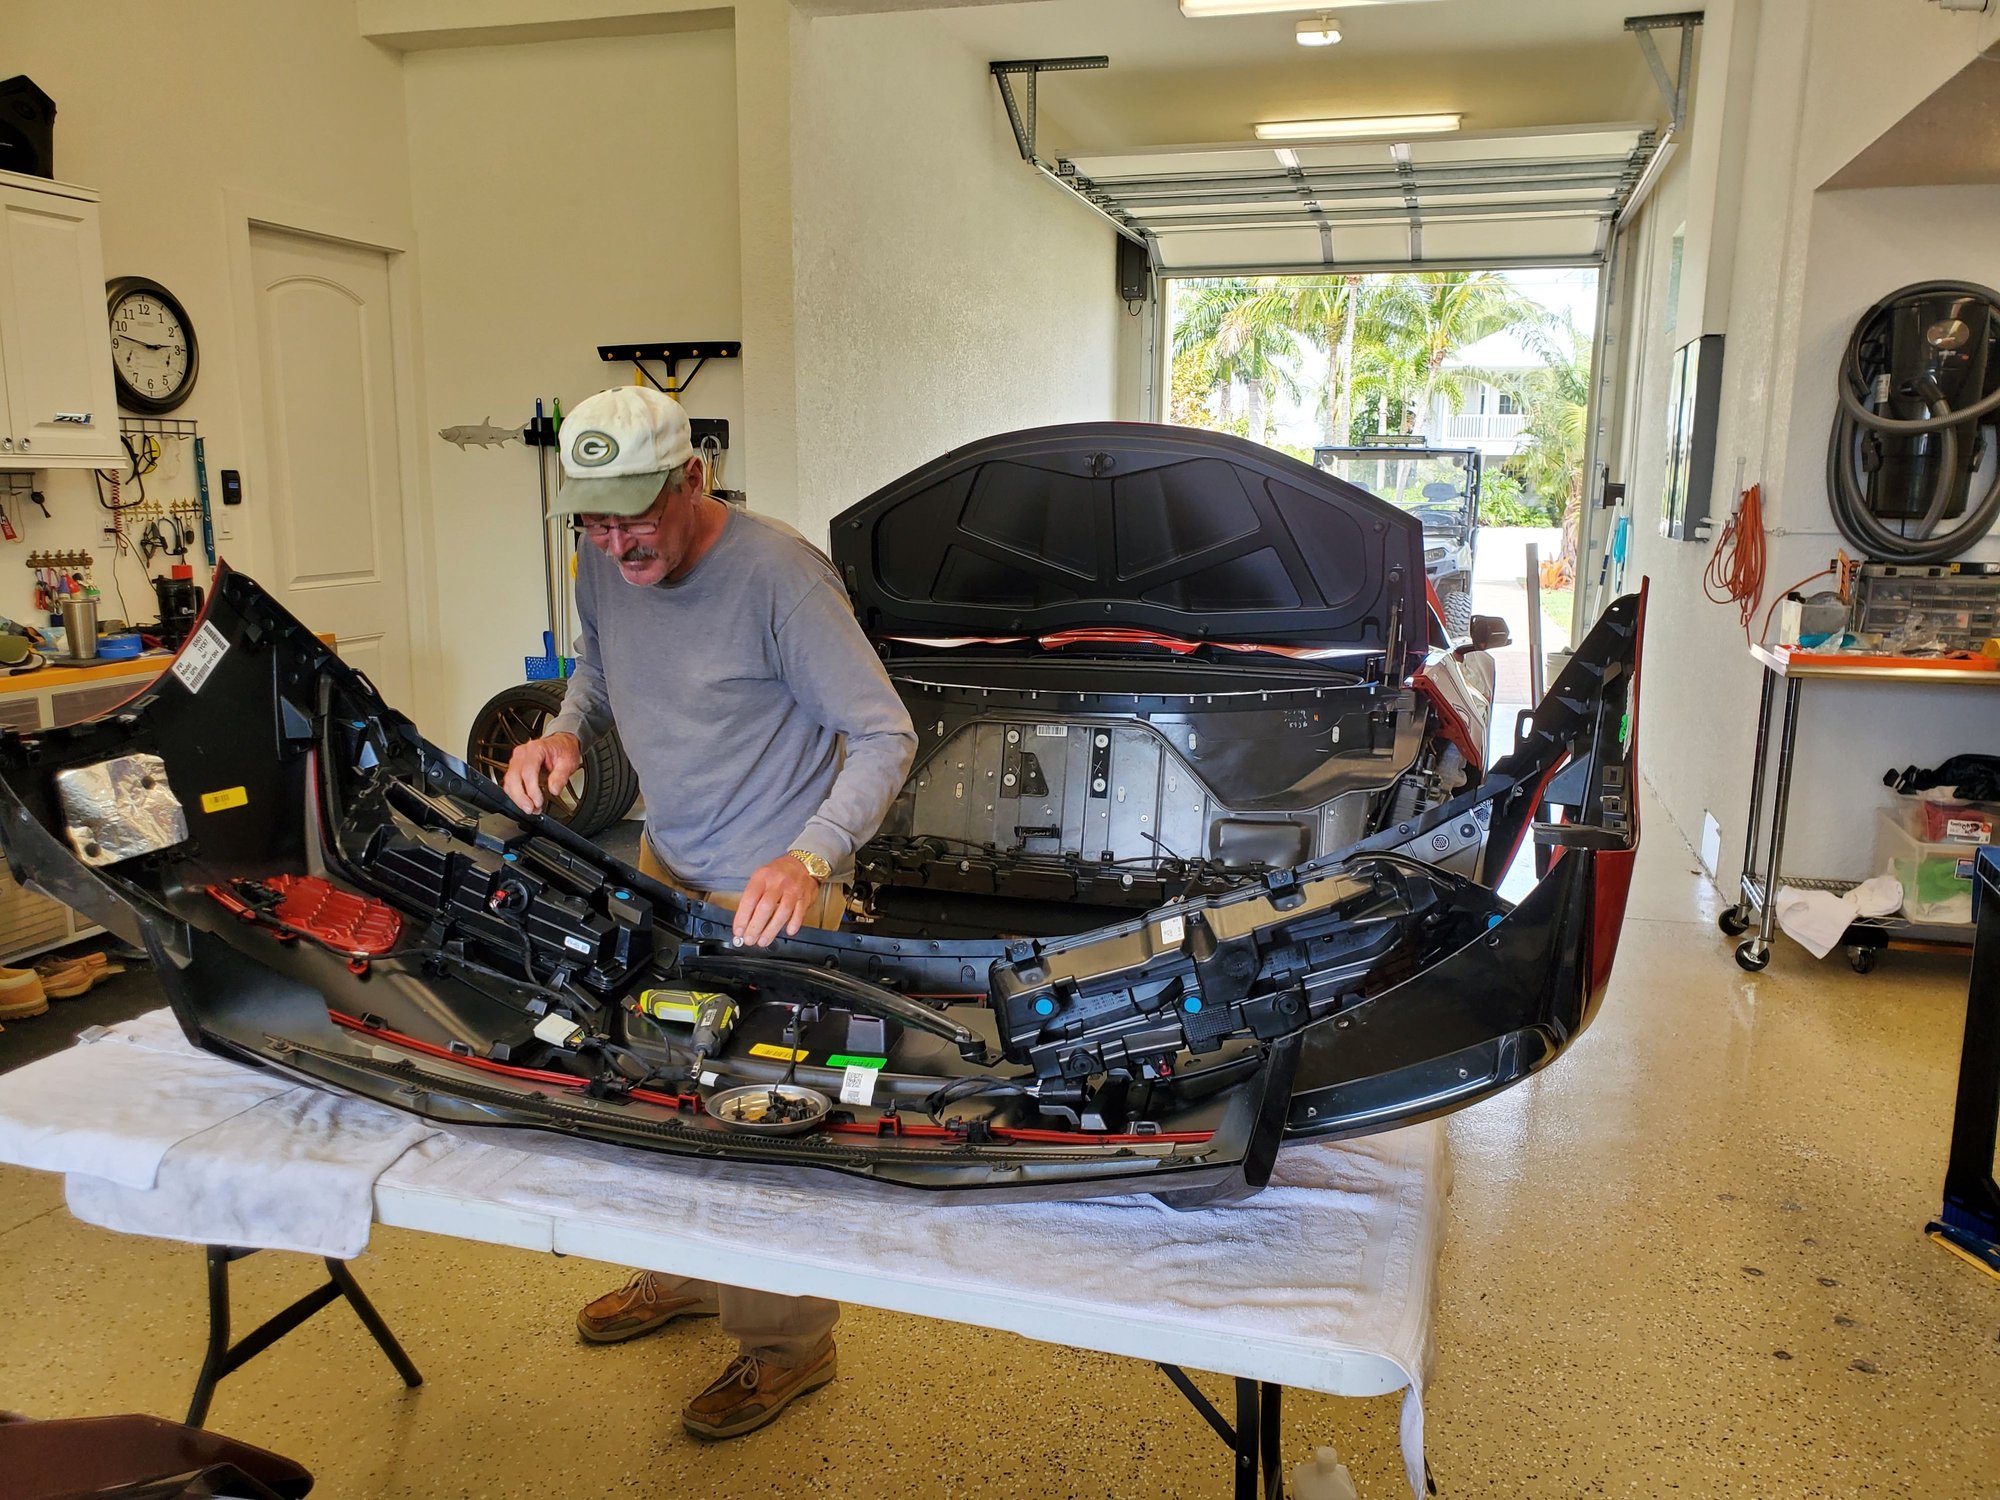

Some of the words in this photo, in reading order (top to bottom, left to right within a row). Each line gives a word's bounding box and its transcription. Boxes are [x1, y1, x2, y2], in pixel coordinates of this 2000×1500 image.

[123, 309, 135, 320] 11
[138, 304, 150, 315] 12
[158, 313, 164, 323] 1
[115, 320, 127, 332] 10
[168, 327, 175, 338] 2
[112, 338, 119, 349] 9
[175, 345, 181, 356] 3
[133, 372, 139, 383] 7
[162, 375, 168, 386] 5
[148, 379, 154, 389] 6
[577, 435, 612, 461] G
